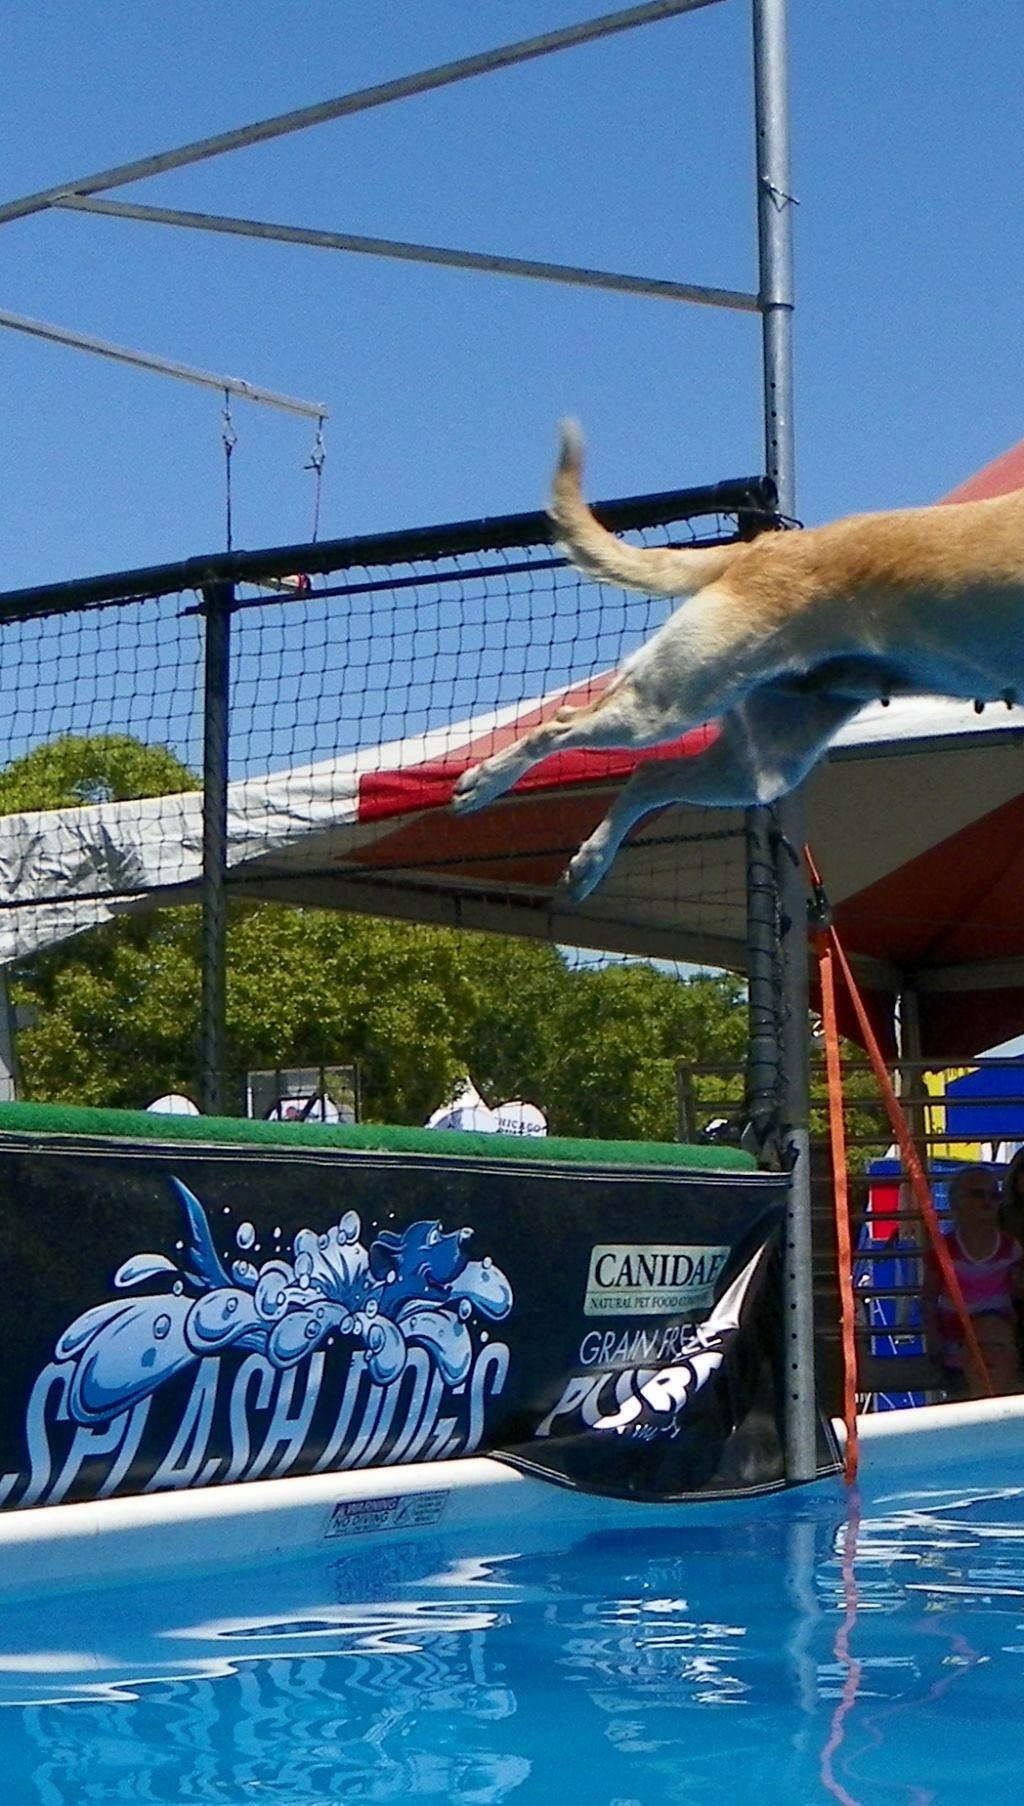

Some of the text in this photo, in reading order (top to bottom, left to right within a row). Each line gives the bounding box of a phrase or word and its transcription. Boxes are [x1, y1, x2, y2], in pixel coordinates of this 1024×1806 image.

[494, 1116, 541, 1132] HICAGO
[590, 1297, 631, 1309] NATURAL
[634, 1296, 650, 1308] PET
[579, 1327, 656, 1364] GRAIN
